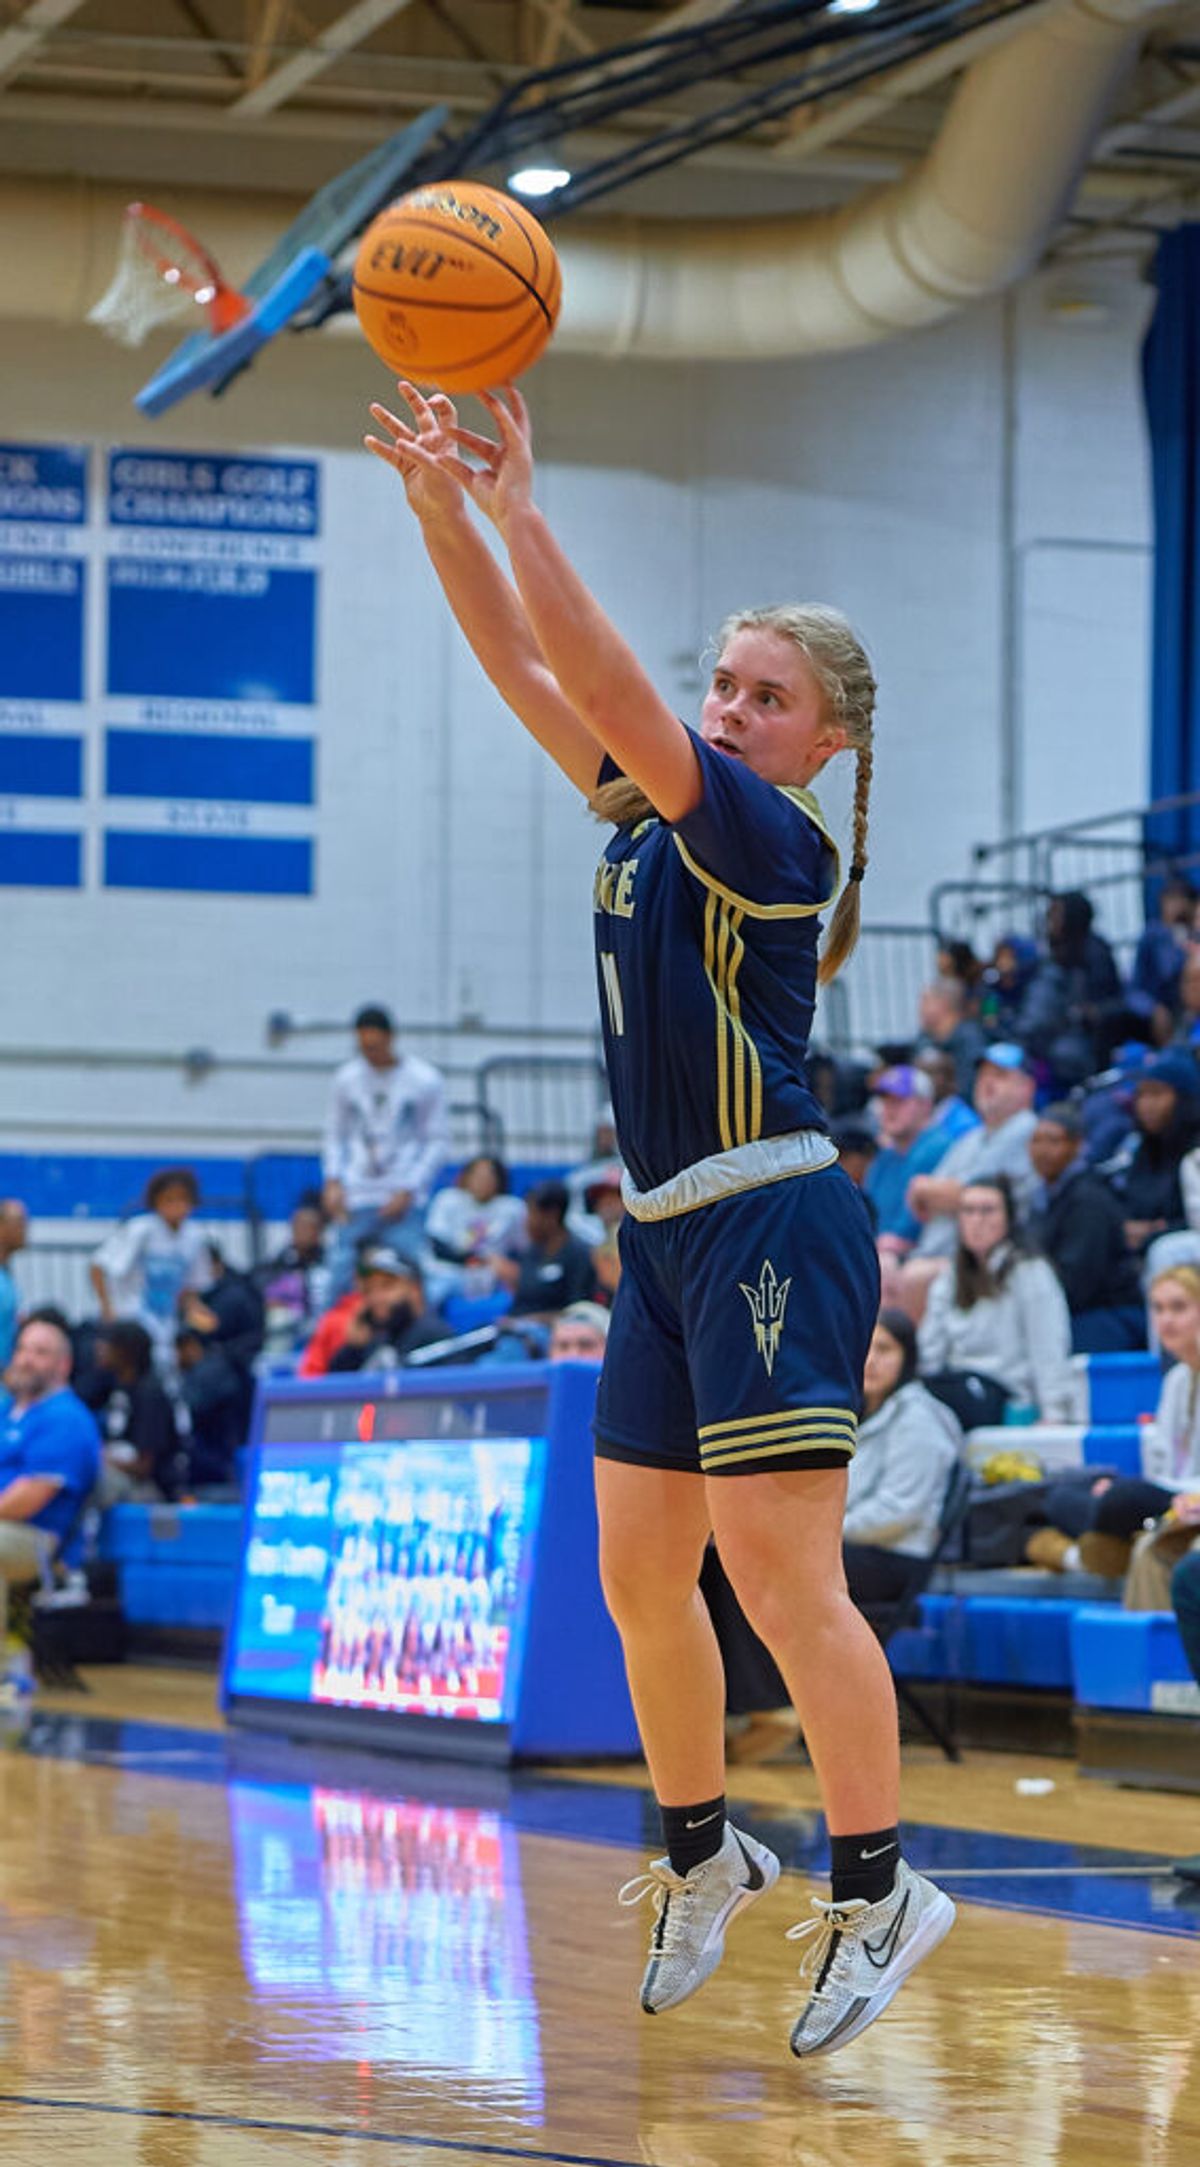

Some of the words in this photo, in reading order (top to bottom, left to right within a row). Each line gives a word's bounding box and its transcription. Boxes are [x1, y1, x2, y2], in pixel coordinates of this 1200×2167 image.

[113, 458, 216, 490] GIRLS
[220, 464, 314, 497] GOLF
[110, 491, 315, 531] CHAMPIONS
